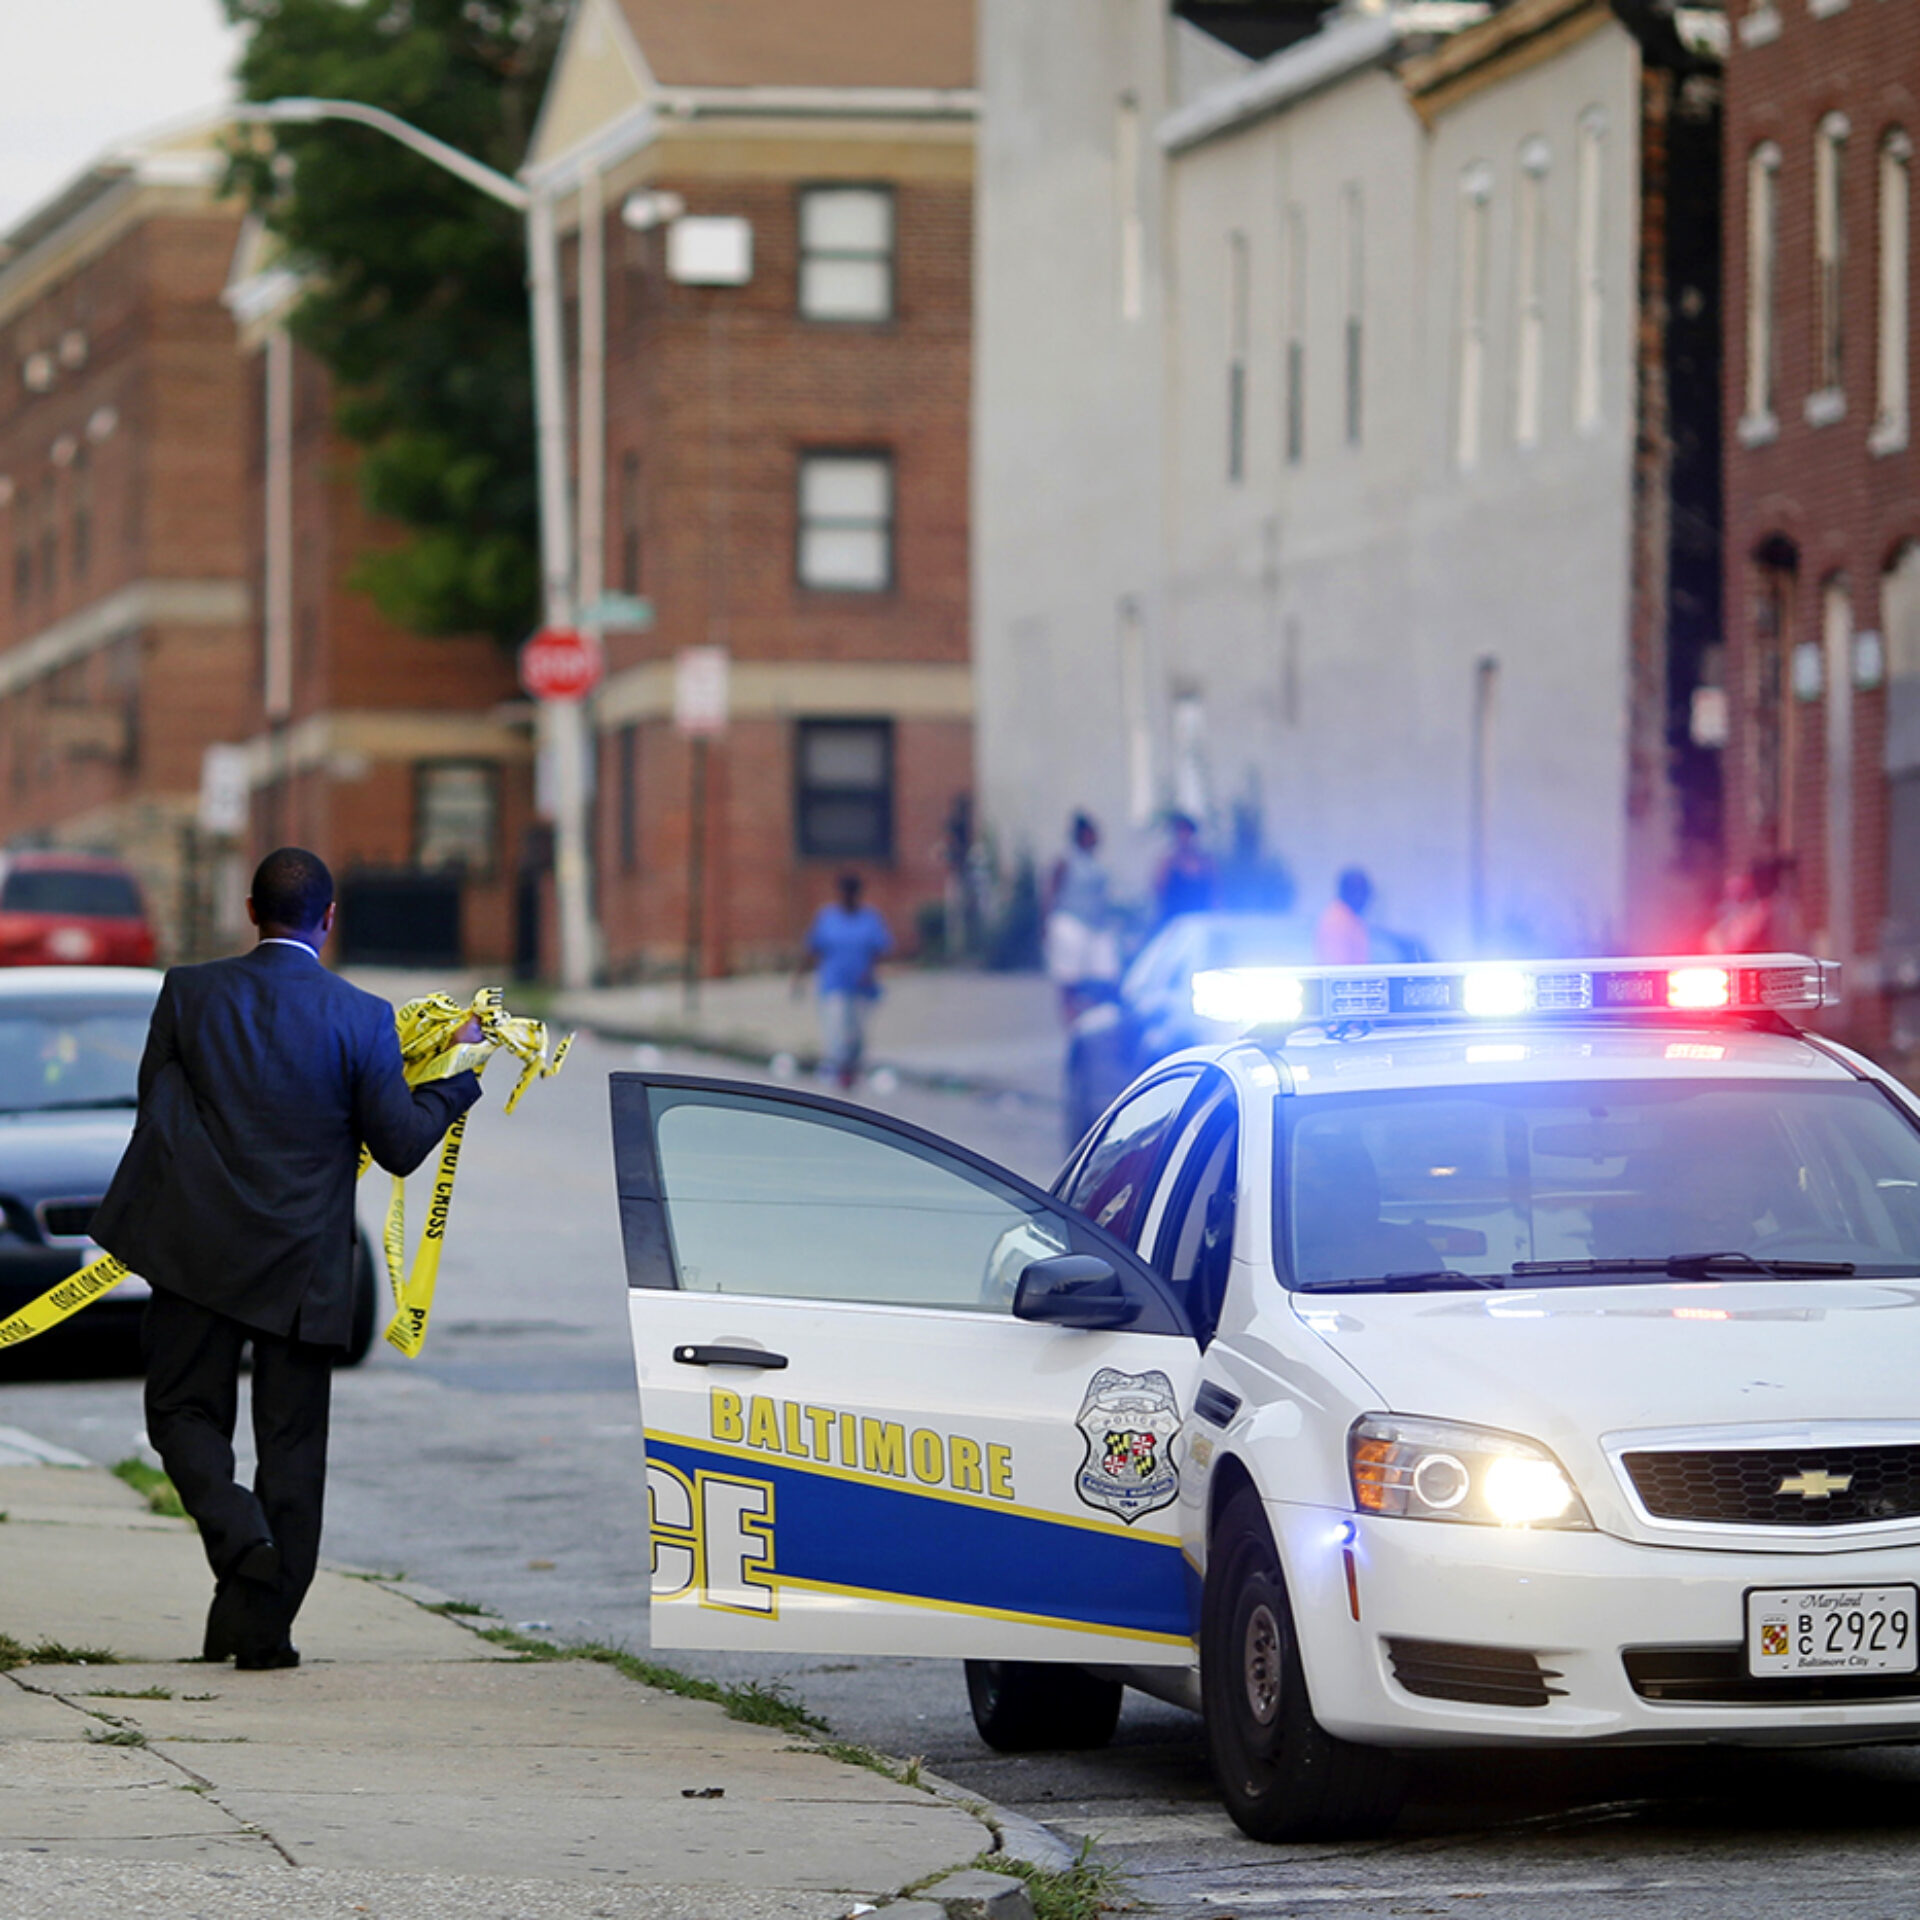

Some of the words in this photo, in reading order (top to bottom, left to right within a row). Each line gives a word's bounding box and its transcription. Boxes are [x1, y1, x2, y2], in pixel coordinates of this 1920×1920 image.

[425, 1182, 453, 1240] CROSS
[1104, 1415, 1157, 1426] POLICE
[709, 1386, 1016, 1500] BALTIMORE
[1800, 1594, 1862, 1610] Maryland
[1824, 1610, 1909, 1653] 2929
[1798, 1656, 1846, 1668] Baltimore
[1849, 1655, 1870, 1667] City
